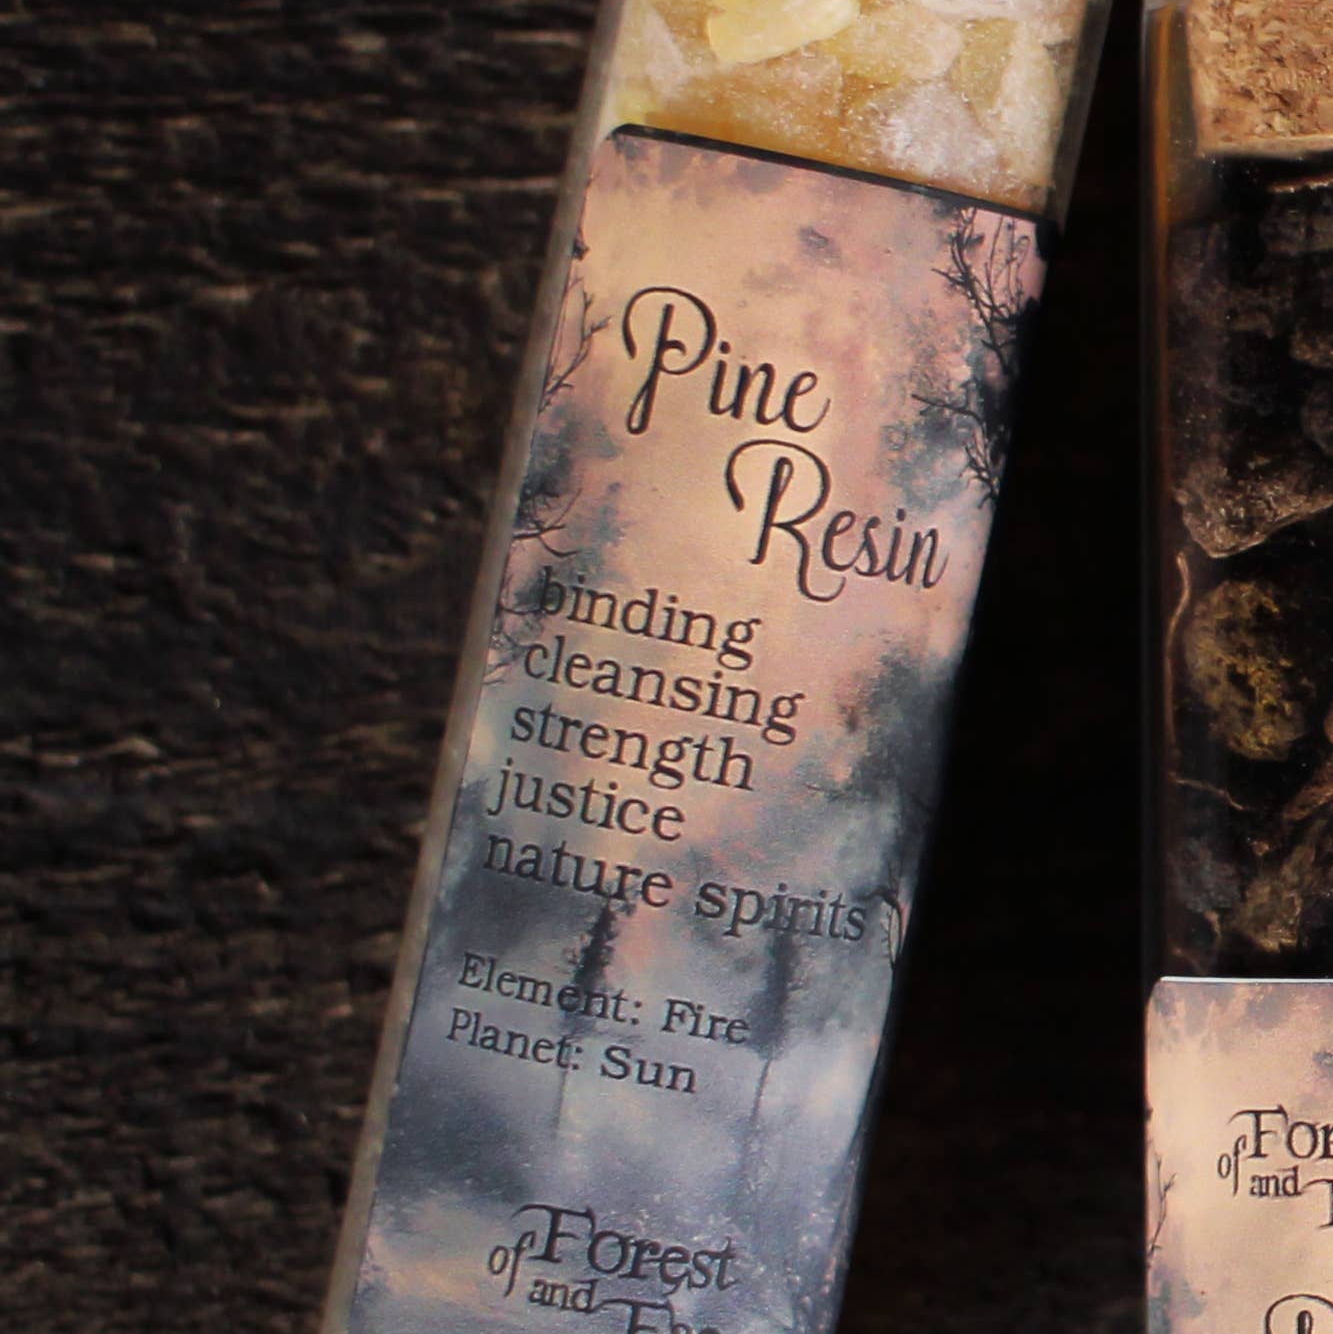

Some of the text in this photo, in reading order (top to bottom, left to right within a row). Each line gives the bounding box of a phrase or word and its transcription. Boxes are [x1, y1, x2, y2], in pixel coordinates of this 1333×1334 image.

[621, 286, 830, 435] Pine
[725, 439, 948, 602] Resin
[539, 568, 762, 670] binding
[523, 634, 806, 745] cleansing
[510, 702, 756, 791] strength
[487, 758, 685, 842] justice
[484, 829, 868, 943] nature spirits
[458, 952, 751, 1045] Element: Fire
[447, 1008, 697, 1095] Planet: Sun
[1218, 1134, 1245, 1195] of
[1249, 1167, 1300, 1197] and
[487, 1203, 740, 1297] of Forest
[529, 1278, 598, 1315] and
